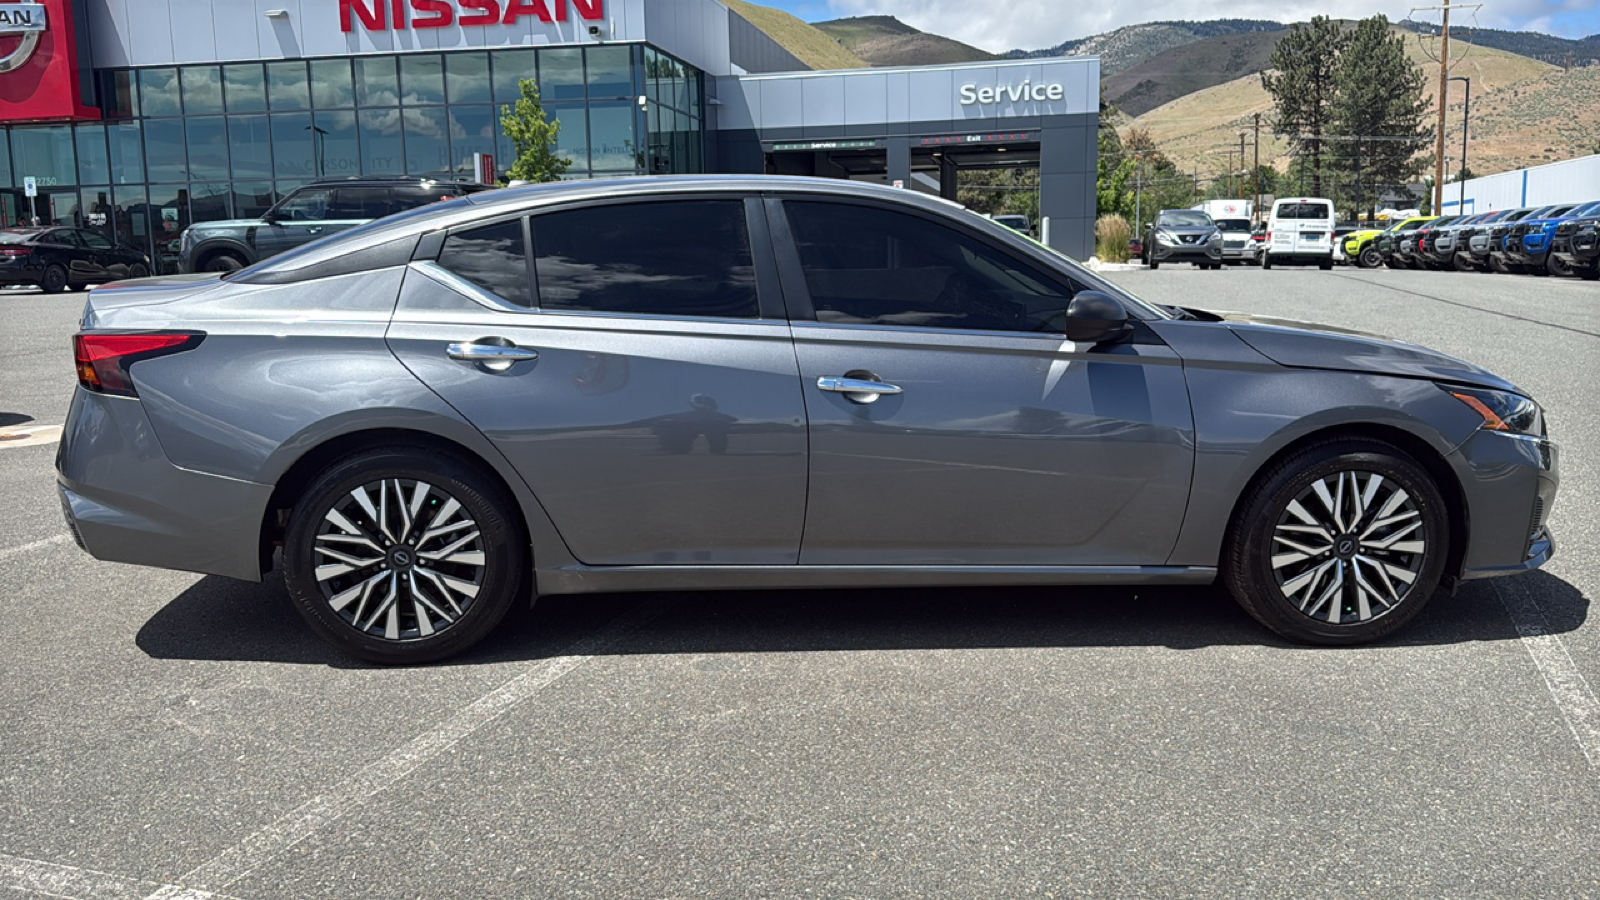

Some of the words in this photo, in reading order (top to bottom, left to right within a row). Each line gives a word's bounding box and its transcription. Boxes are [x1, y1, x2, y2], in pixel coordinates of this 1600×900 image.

[341, 0, 603, 32] NISSAN
[960, 80, 1063, 105] Service
[811, 141, 837, 149] Service
[304, 158, 358, 171] CRSON
[368, 156, 393, 170] ITY
[36, 177, 57, 186] 2750
